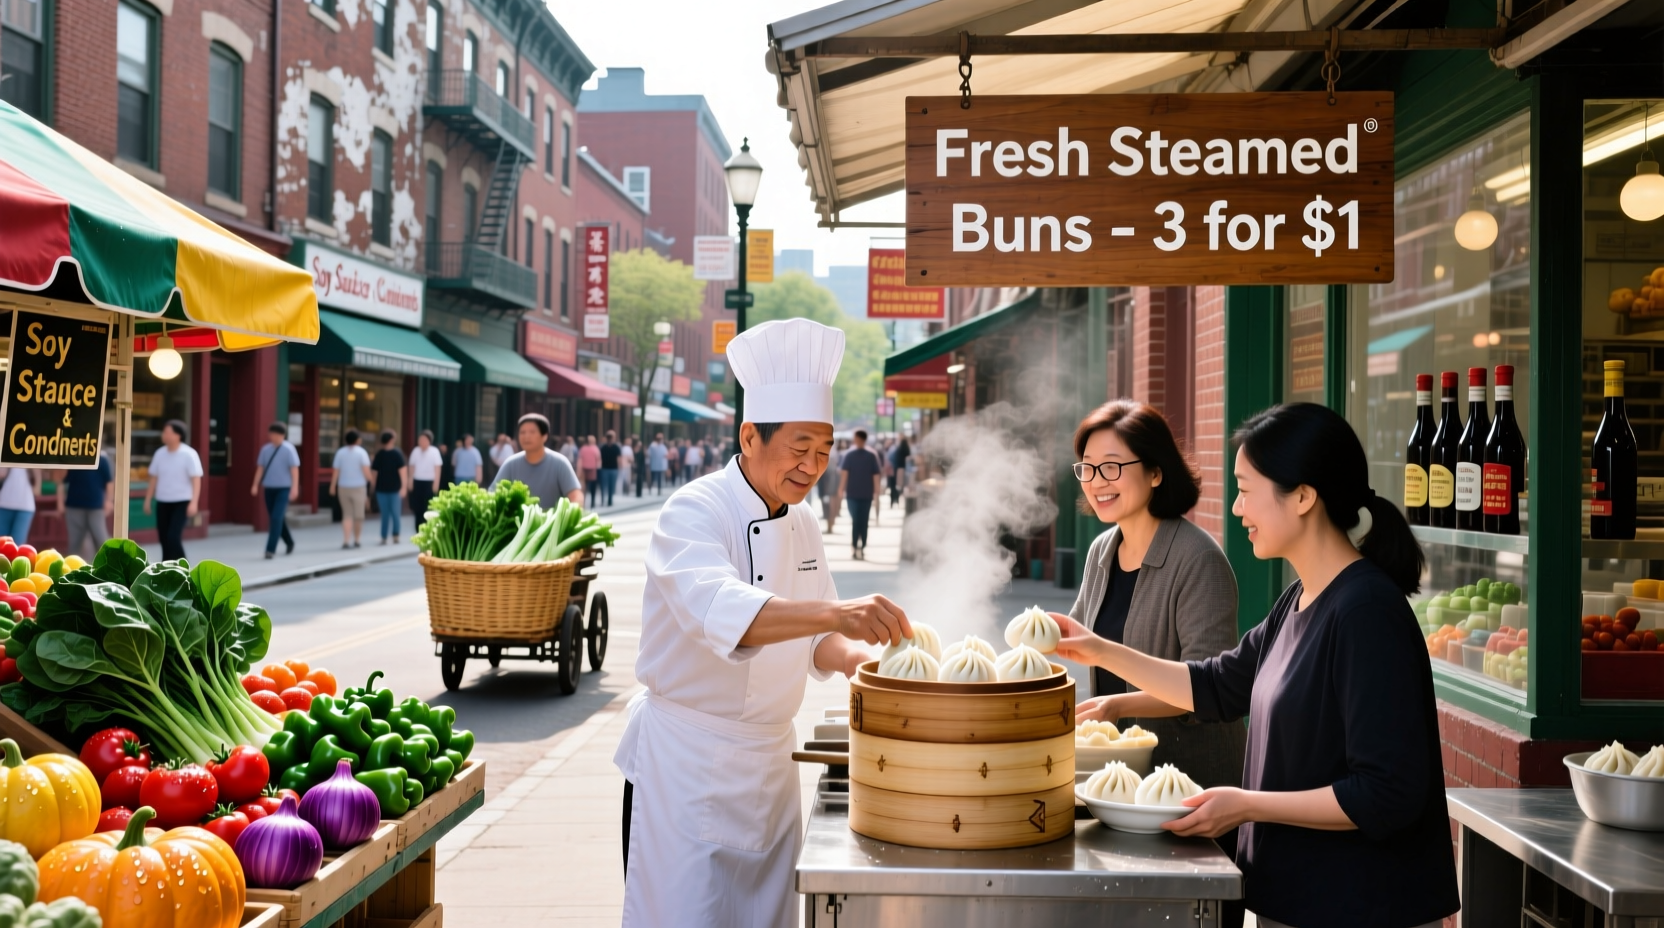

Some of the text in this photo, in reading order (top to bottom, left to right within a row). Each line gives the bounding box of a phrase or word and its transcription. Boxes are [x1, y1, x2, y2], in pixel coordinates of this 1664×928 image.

[936, 123, 1358, 178] Fresh Steamed
[952, 202, 1093, 253] Buns
[1152, 200, 1187, 252] 3
[1203, 199, 1286, 251] for
[1301, 194, 1359, 258] $1
[25, 321, 72, 370] Soy
[62, 407, 73, 428] &
